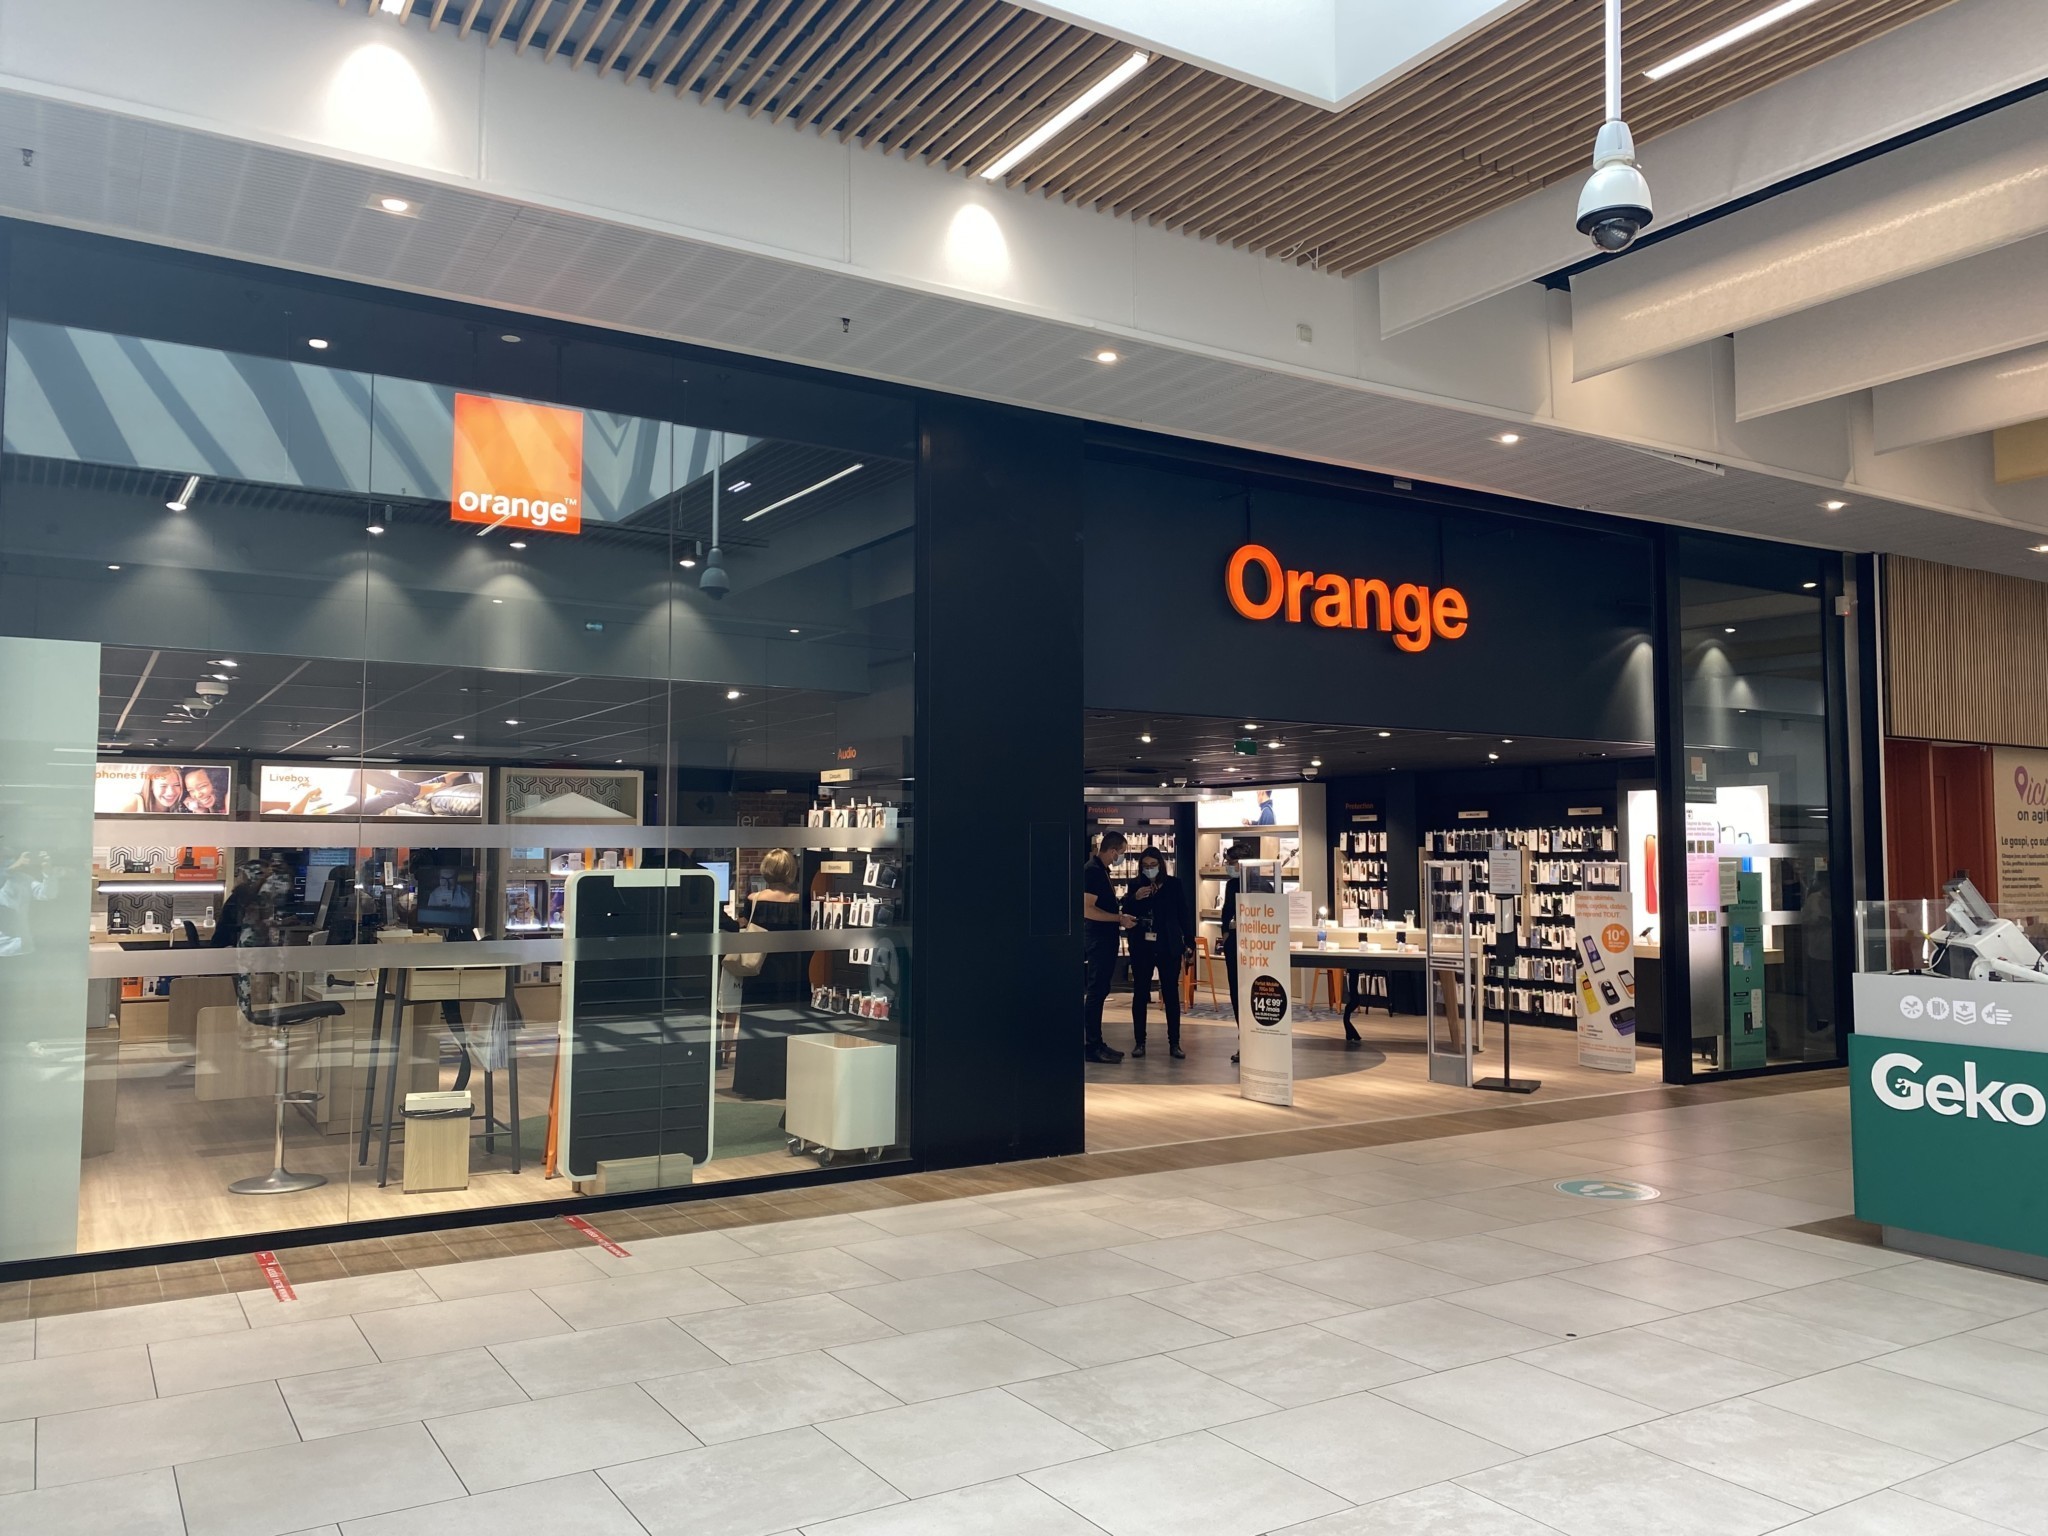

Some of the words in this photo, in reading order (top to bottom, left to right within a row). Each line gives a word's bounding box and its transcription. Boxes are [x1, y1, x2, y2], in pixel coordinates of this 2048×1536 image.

[459, 491, 568, 527] orange
[1225, 544, 1469, 652] Orange
[837, 747, 857, 760] Audio
[270, 773, 310, 783] Livebox
[1088, 806, 1119, 814] Protection
[2017, 810, 2030, 821] on
[1239, 903, 1261, 917] Pour
[1264, 904, 1275, 917] le
[1239, 920, 1281, 934] meilleur
[1240, 937, 1248, 949] et
[1250, 939, 1276, 953] pour
[1240, 953, 1247, 966] le
[1249, 953, 1269, 969] prix
[1871, 1052, 2046, 1126] Geko
